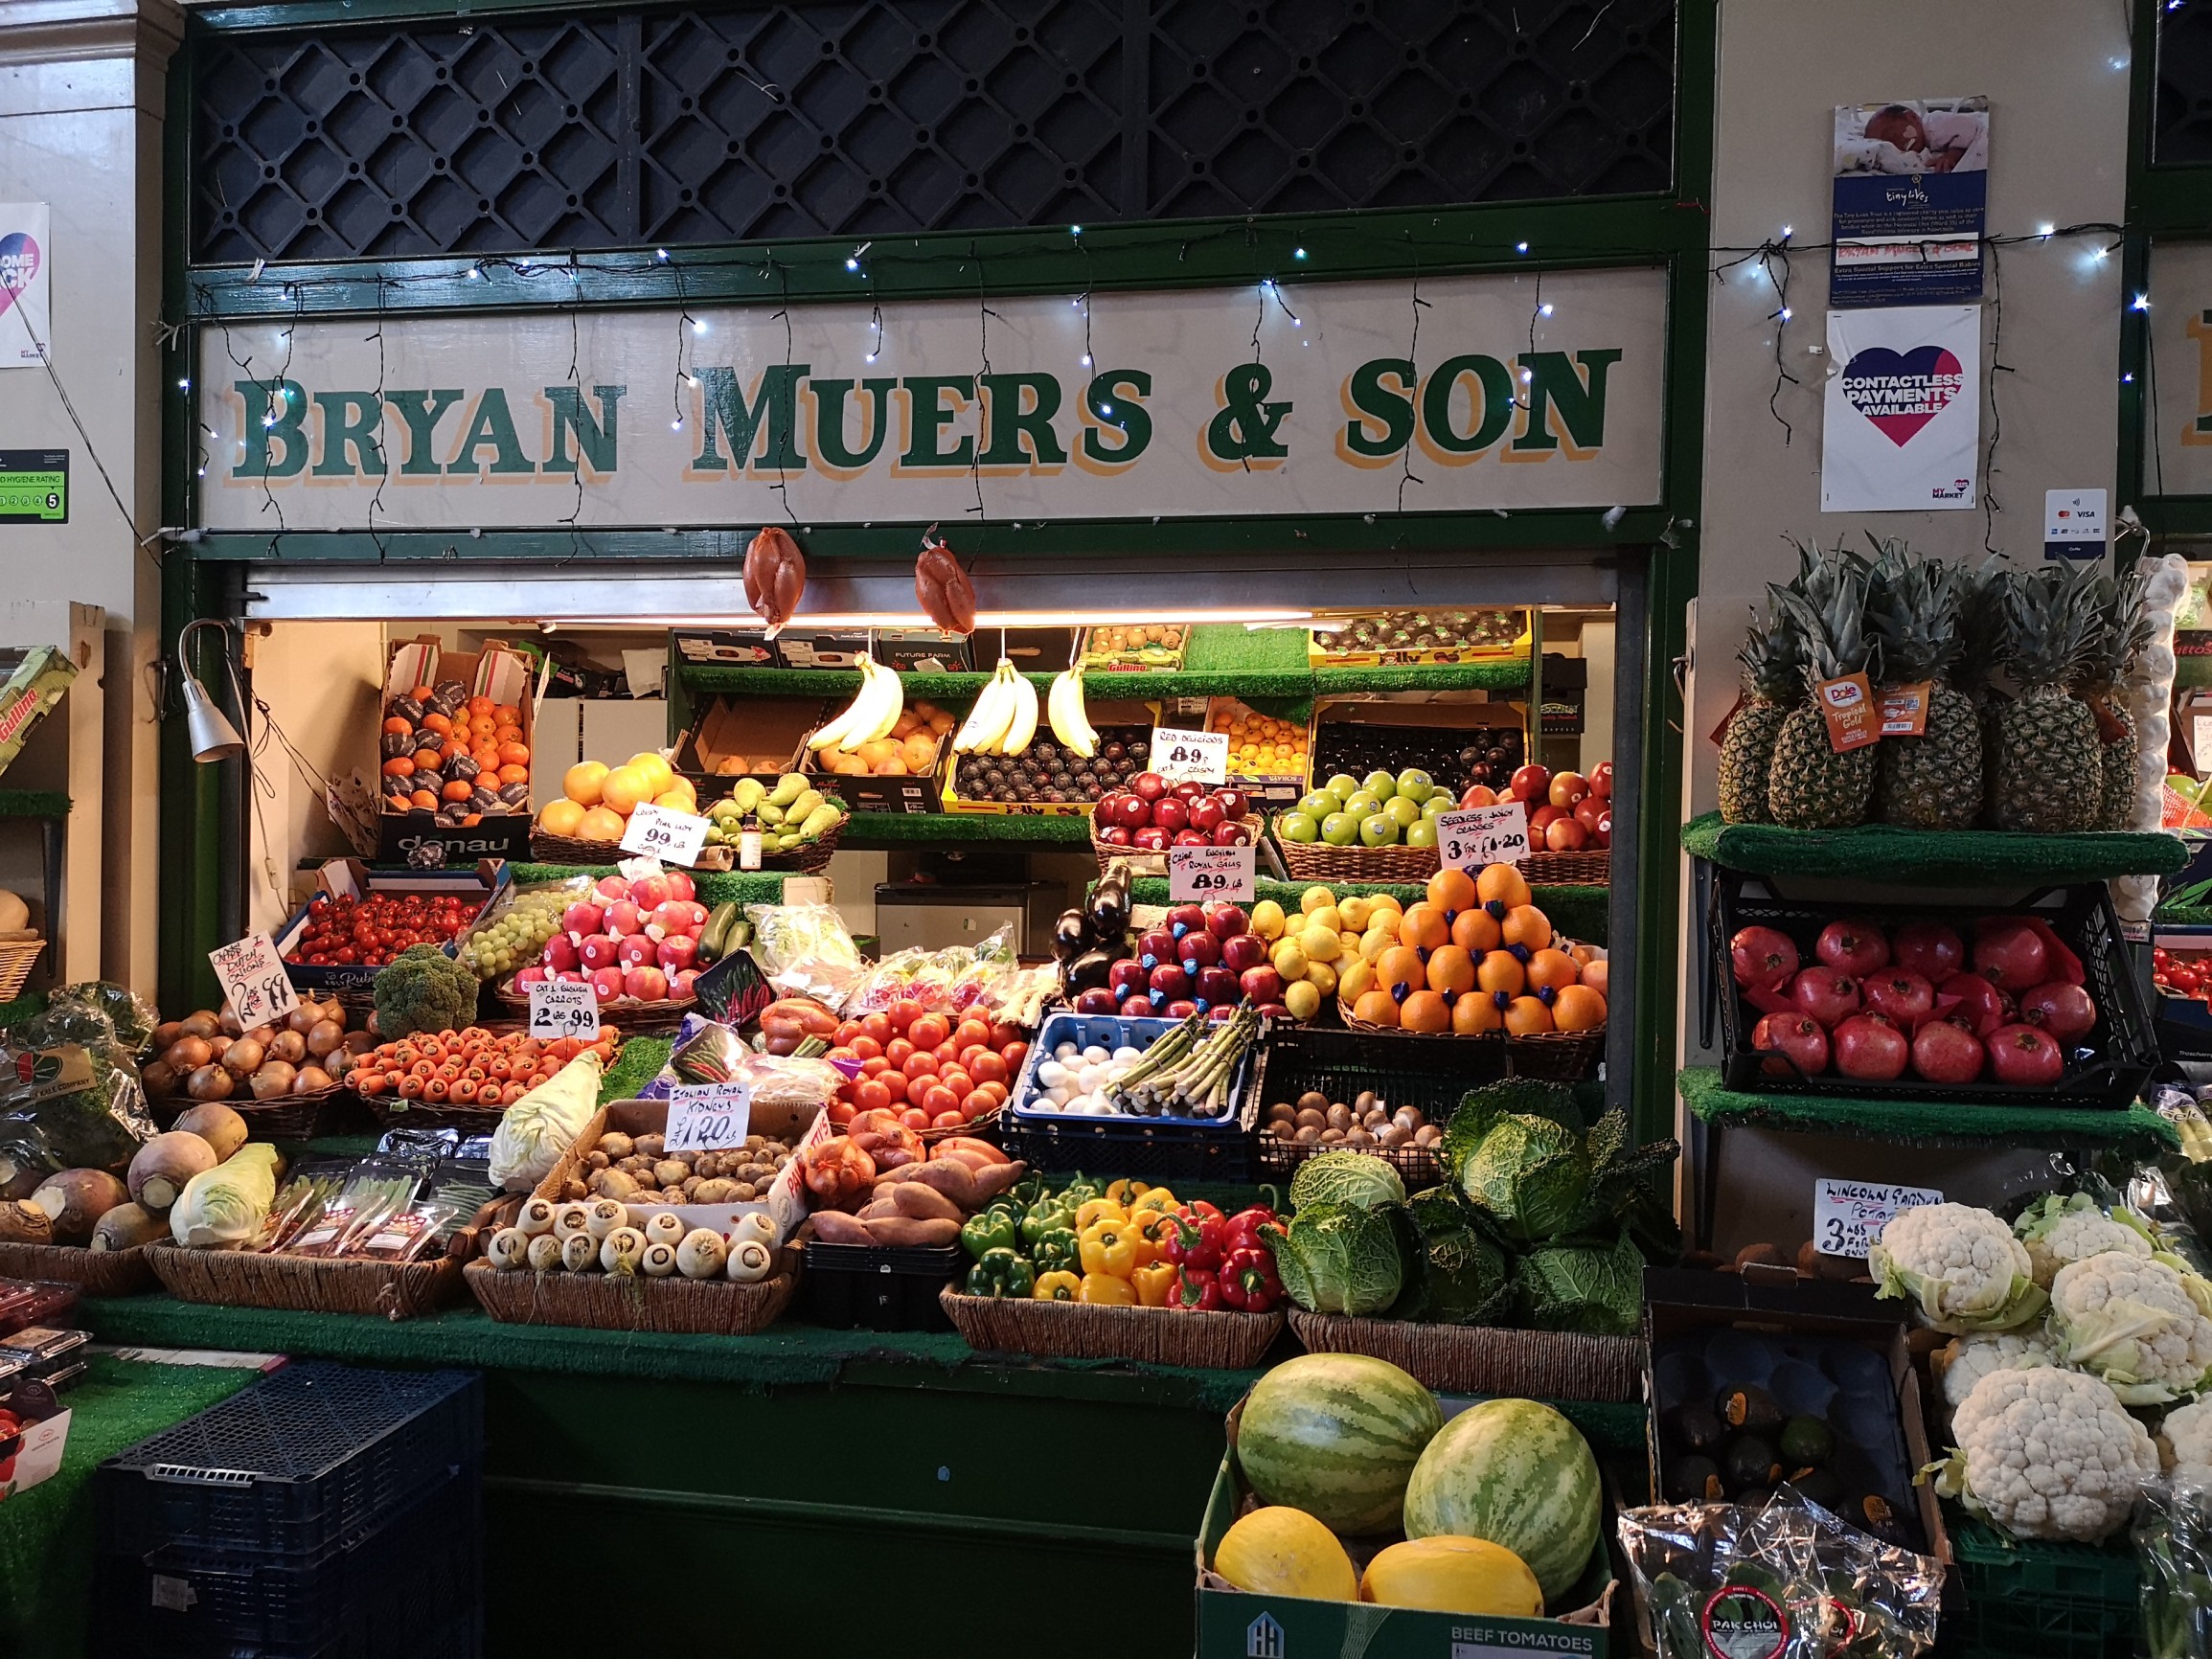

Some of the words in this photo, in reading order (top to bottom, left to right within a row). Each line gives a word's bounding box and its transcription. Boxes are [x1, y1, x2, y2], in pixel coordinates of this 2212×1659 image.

[0, 267, 35, 288] CK
[1842, 374, 1964, 389] CONTACTLESS
[1847, 387, 1957, 404] PAYMENTS
[227, 378, 627, 482] BRYAN
[688, 364, 1152, 476] MUERS
[1201, 362, 1292, 463] &
[1340, 348, 1623, 460] SON
[1861, 402, 1943, 416] AVAILABLE
[48, 494, 57, 508] 5
[1831, 686, 1857, 700] Dole
[1833, 703, 1867, 722] Tropical
[1842, 716, 1862, 729] Gold
[1160, 731, 1177, 741] RED
[1441, 813, 1483, 827] SEEDLESS
[645, 828, 671, 846] 99
[1448, 840, 1463, 860] 3
[1189, 861, 1213, 870] ROYAL
[227, 948, 257, 972] DUTCH
[545, 995, 582, 1005] CARROTS
[535, 1008, 553, 1026] 2
[57, 1078, 90, 1091] COMPANY
[673, 1087, 710, 1101] ITALIAN
[717, 1084, 742, 1096] ROYAL
[687, 1101, 731, 1114] KIDNEYS
[1826, 1182, 1889, 1202] LINCOLN
[1822, 1217, 1845, 1252] 3
[1712, 1620, 1741, 1629] PAK
[1744, 1621, 1778, 1630] CHOI
[1451, 1626, 1494, 1642] BEEF
[1496, 1629, 1593, 1651] TOMATOES
